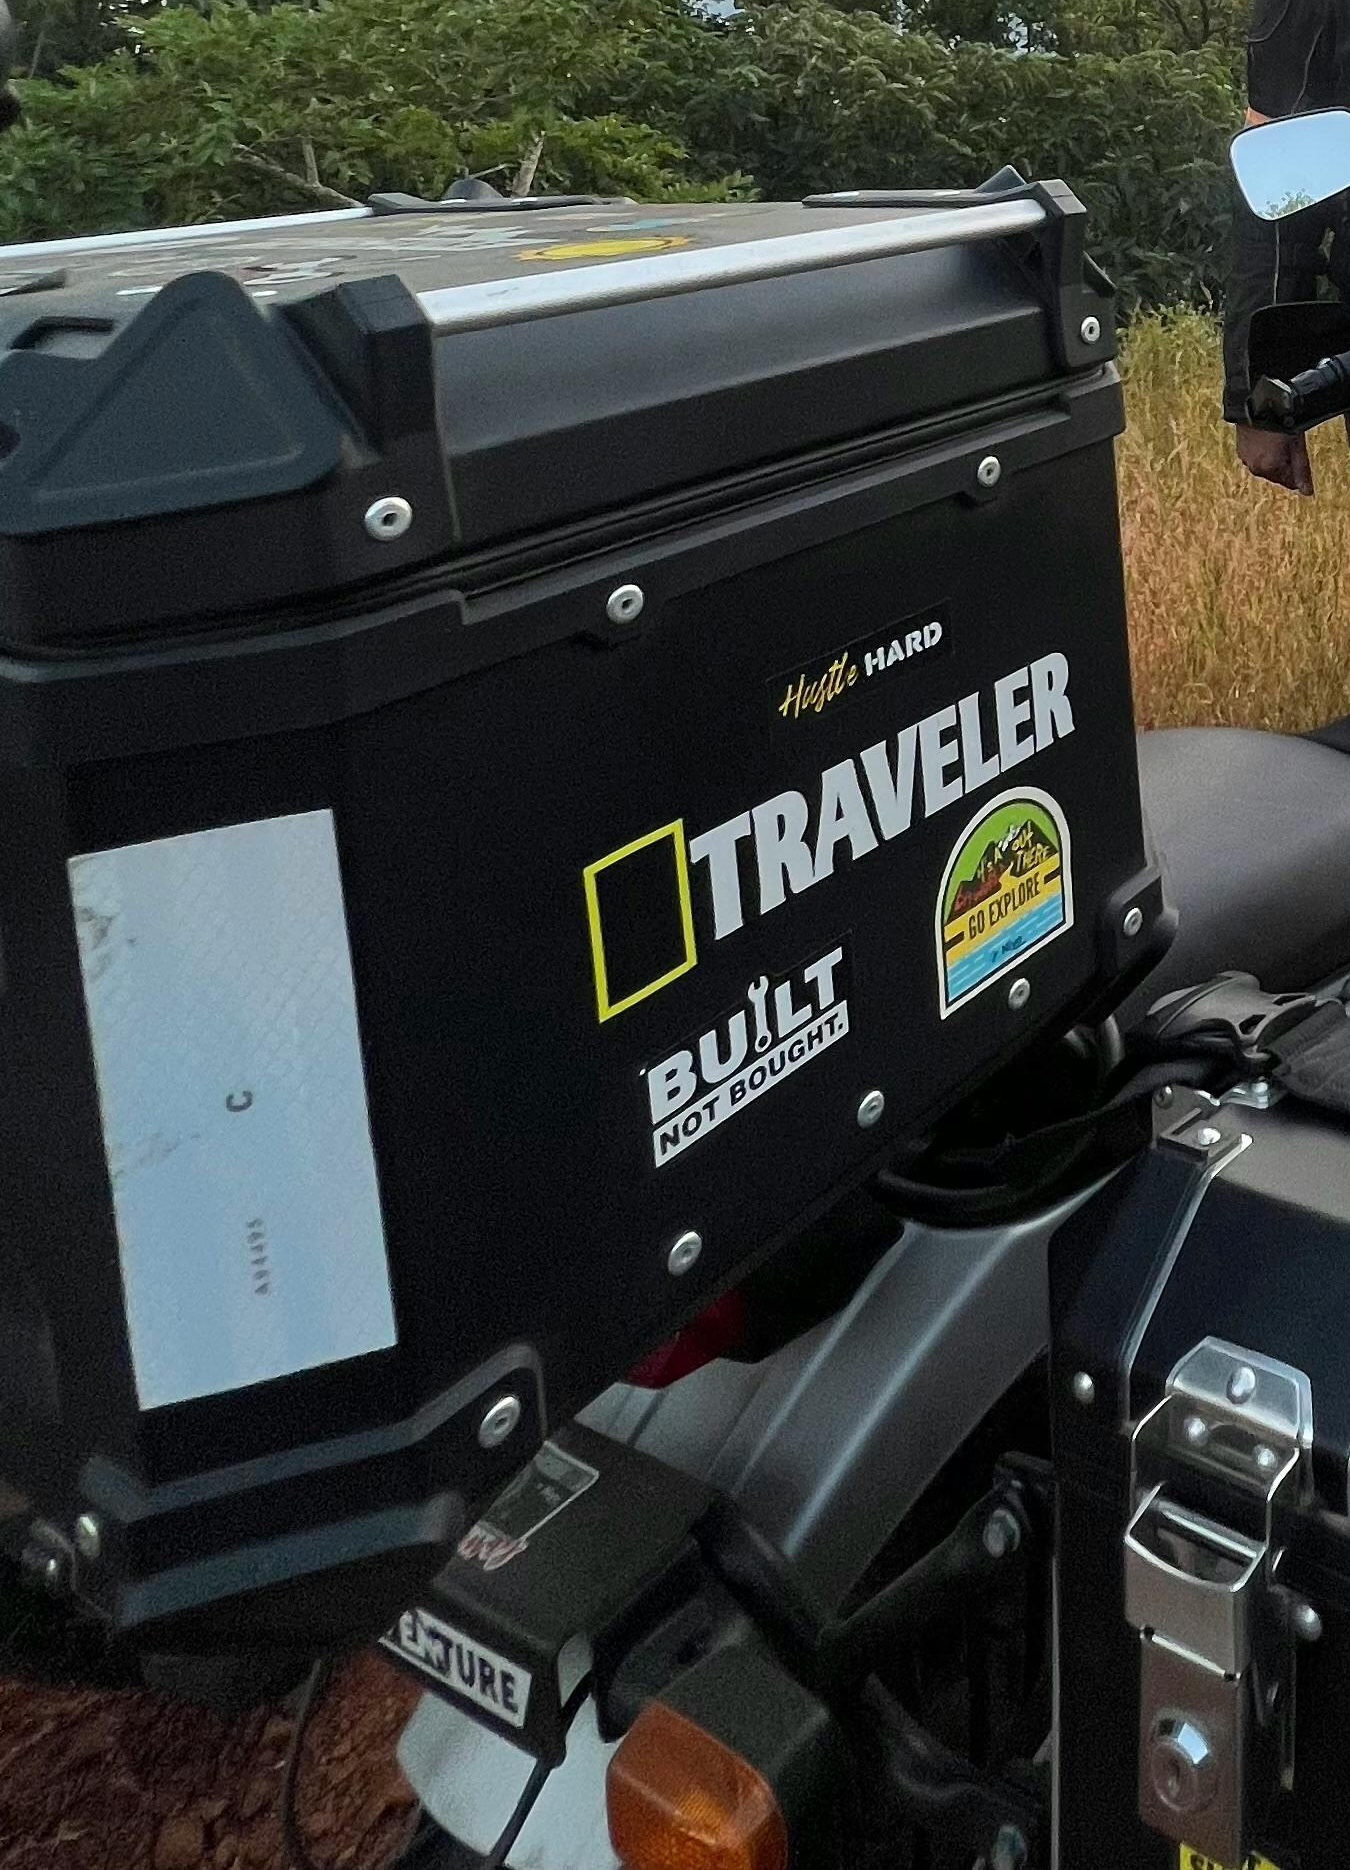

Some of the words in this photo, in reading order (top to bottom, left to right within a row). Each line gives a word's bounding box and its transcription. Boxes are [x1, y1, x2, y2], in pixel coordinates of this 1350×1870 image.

[779, 652, 860, 720] Hustle
[863, 620, 943, 677] HARD
[690, 652, 1075, 941] TRAVELER
[968, 909, 986, 941] GO
[988, 871, 1041, 927] EXPLORE
[659, 1101, 720, 1157] NOT
